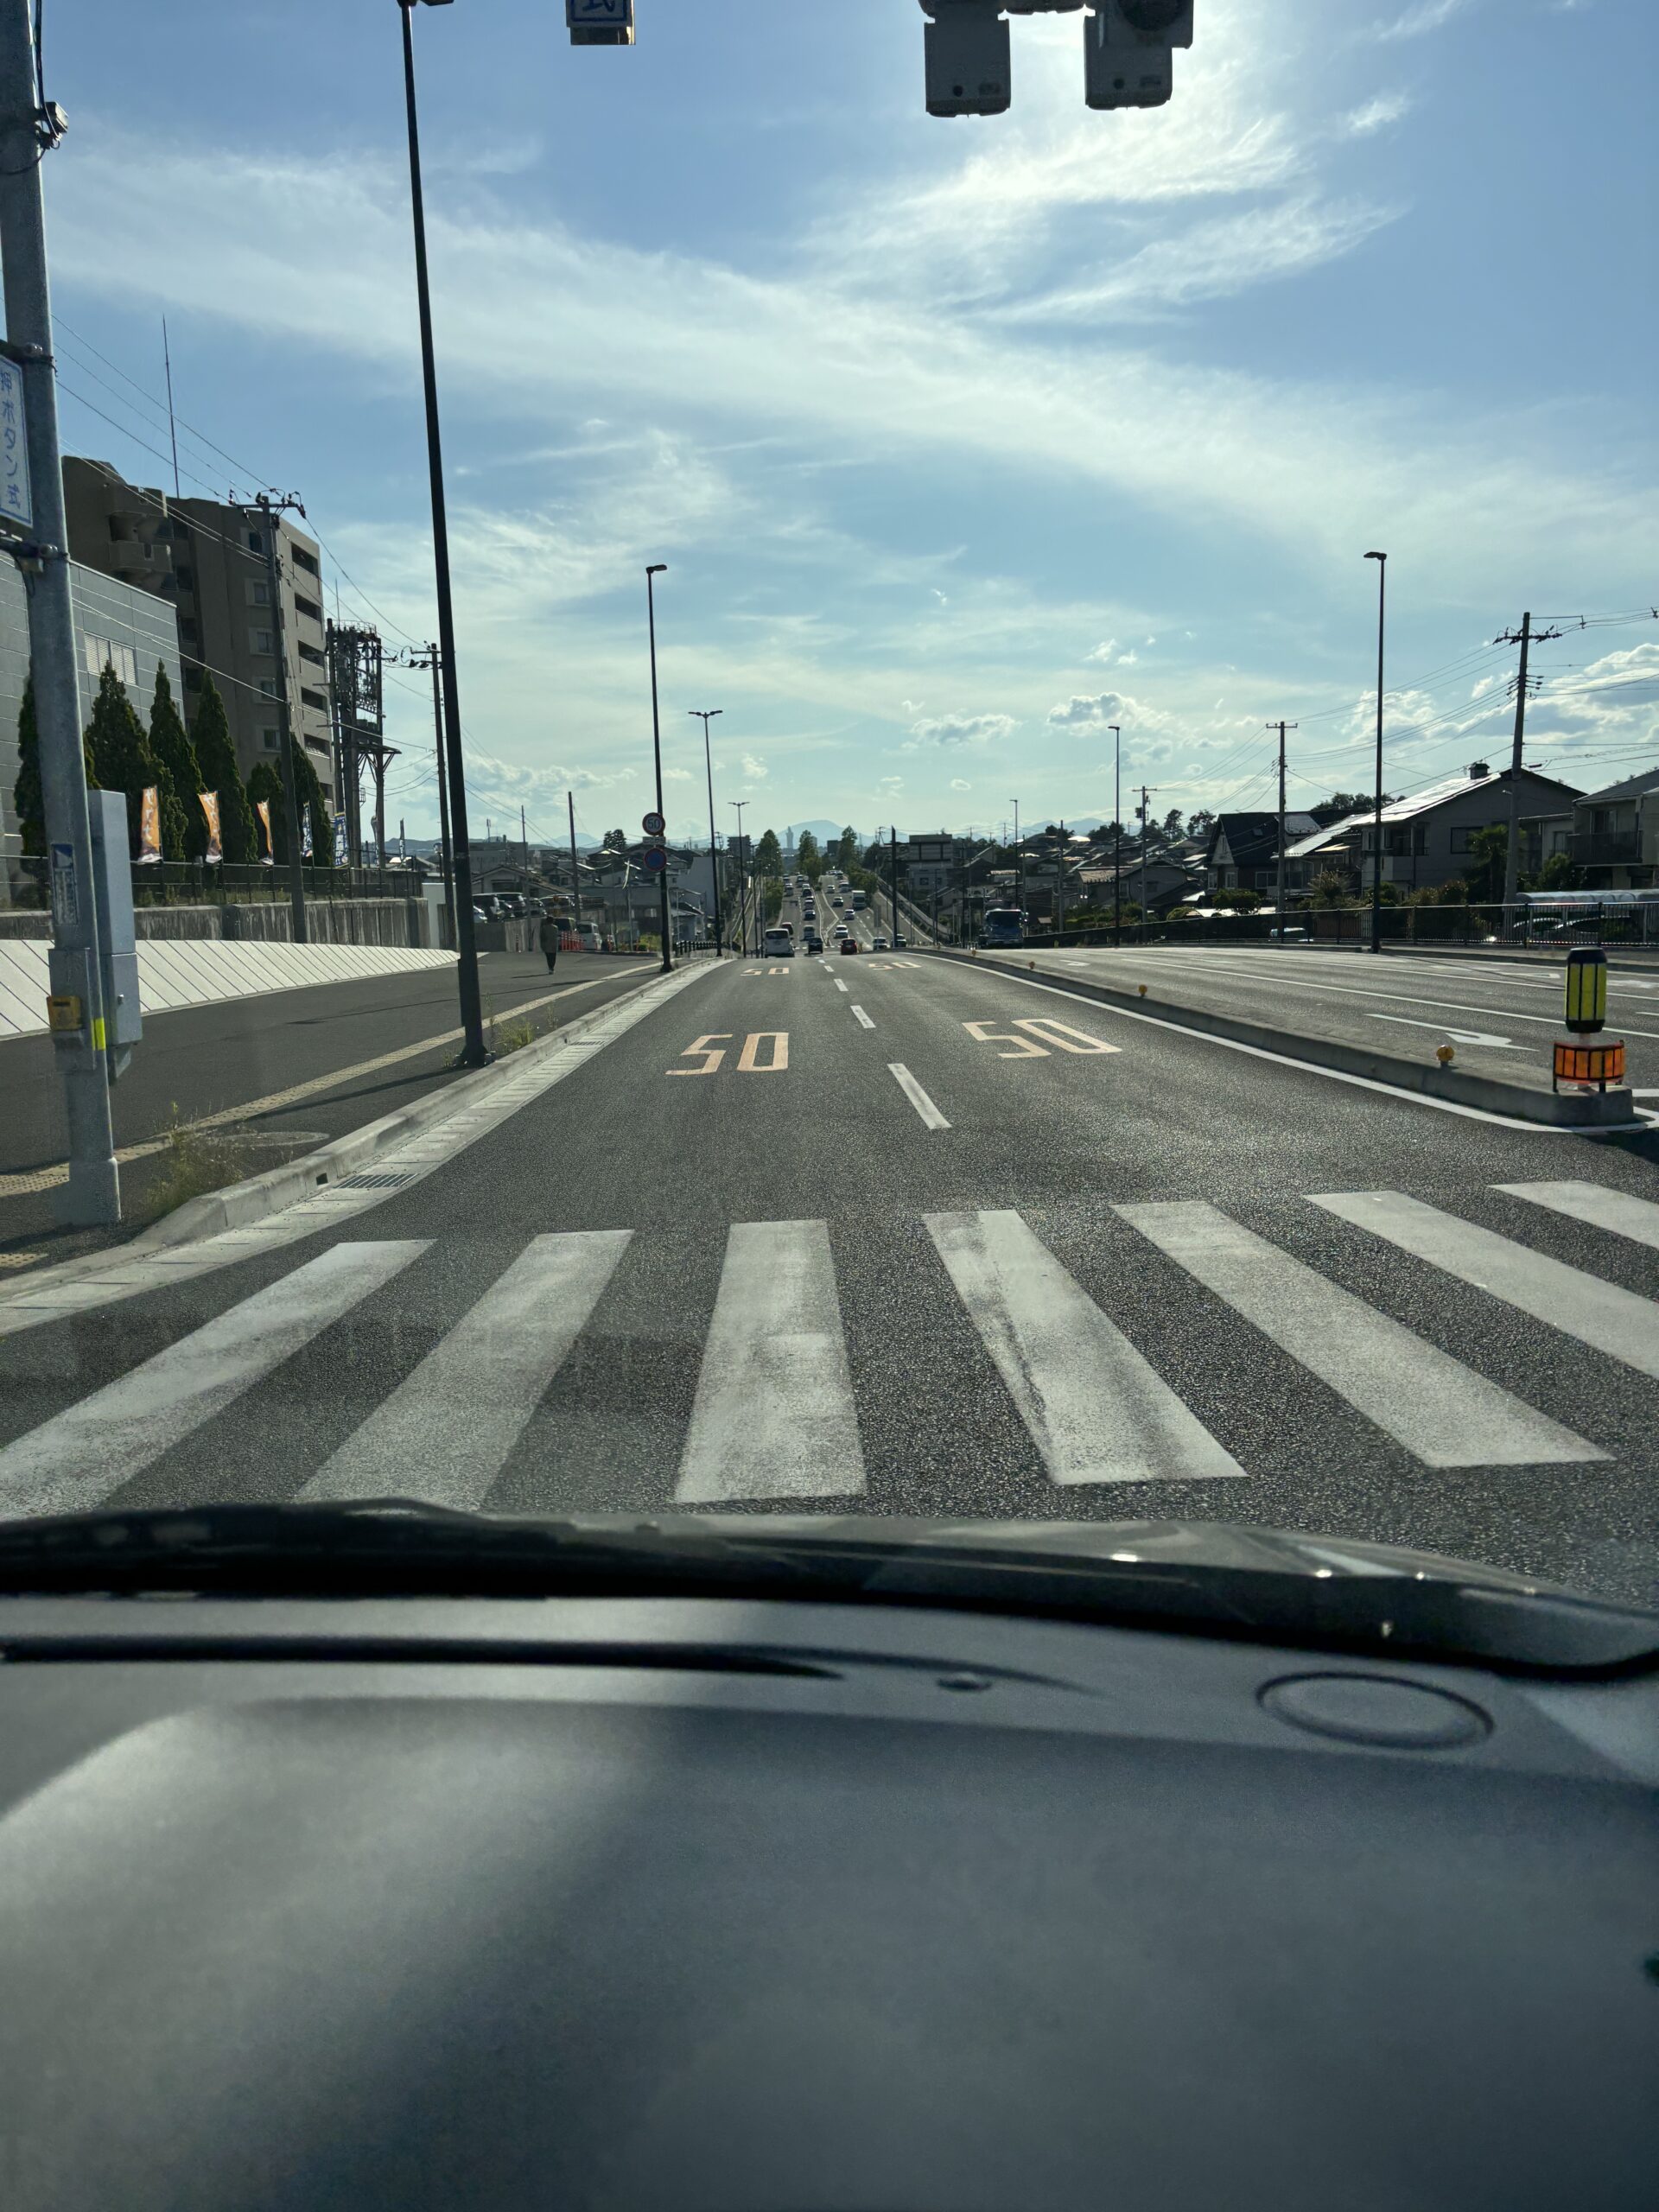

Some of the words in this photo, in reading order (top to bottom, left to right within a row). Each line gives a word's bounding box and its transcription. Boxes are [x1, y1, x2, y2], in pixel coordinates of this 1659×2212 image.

[0, 369, 22, 510] 押ボタン式
[647, 817, 661, 830] 50
[740, 967, 790, 976] 50
[868, 962, 922, 970] 50
[962, 1019, 1122, 1058] 50
[665, 1032, 789, 1076] 50
